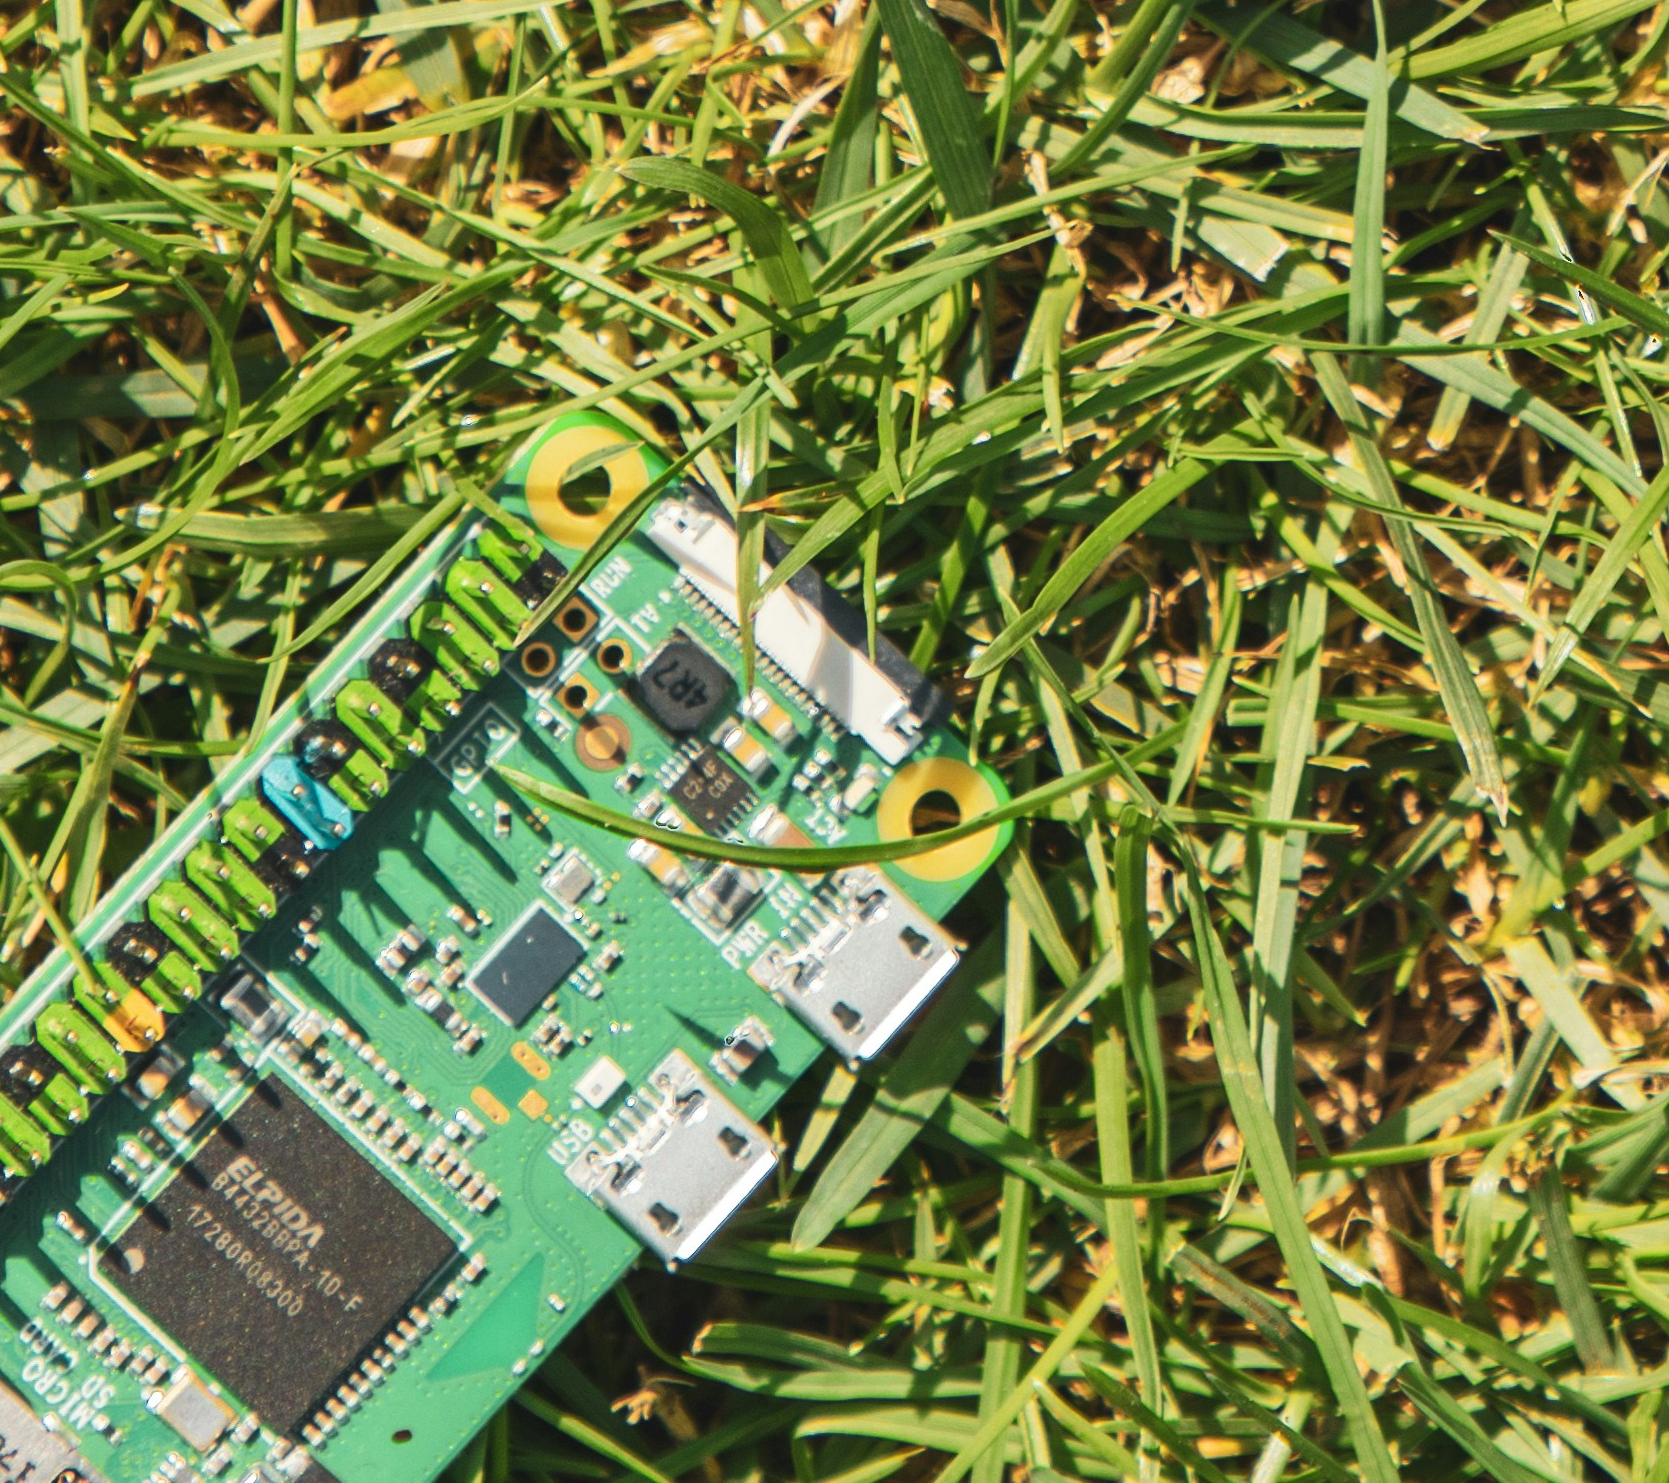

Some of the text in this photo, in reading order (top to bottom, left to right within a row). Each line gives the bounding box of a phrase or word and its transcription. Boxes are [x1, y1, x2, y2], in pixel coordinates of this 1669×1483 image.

[590, 555, 634, 600] RUN
[721, 919, 770, 970] PWR
[546, 1116, 595, 1166] USB
[21, 1355, 98, 1431] MICRO
